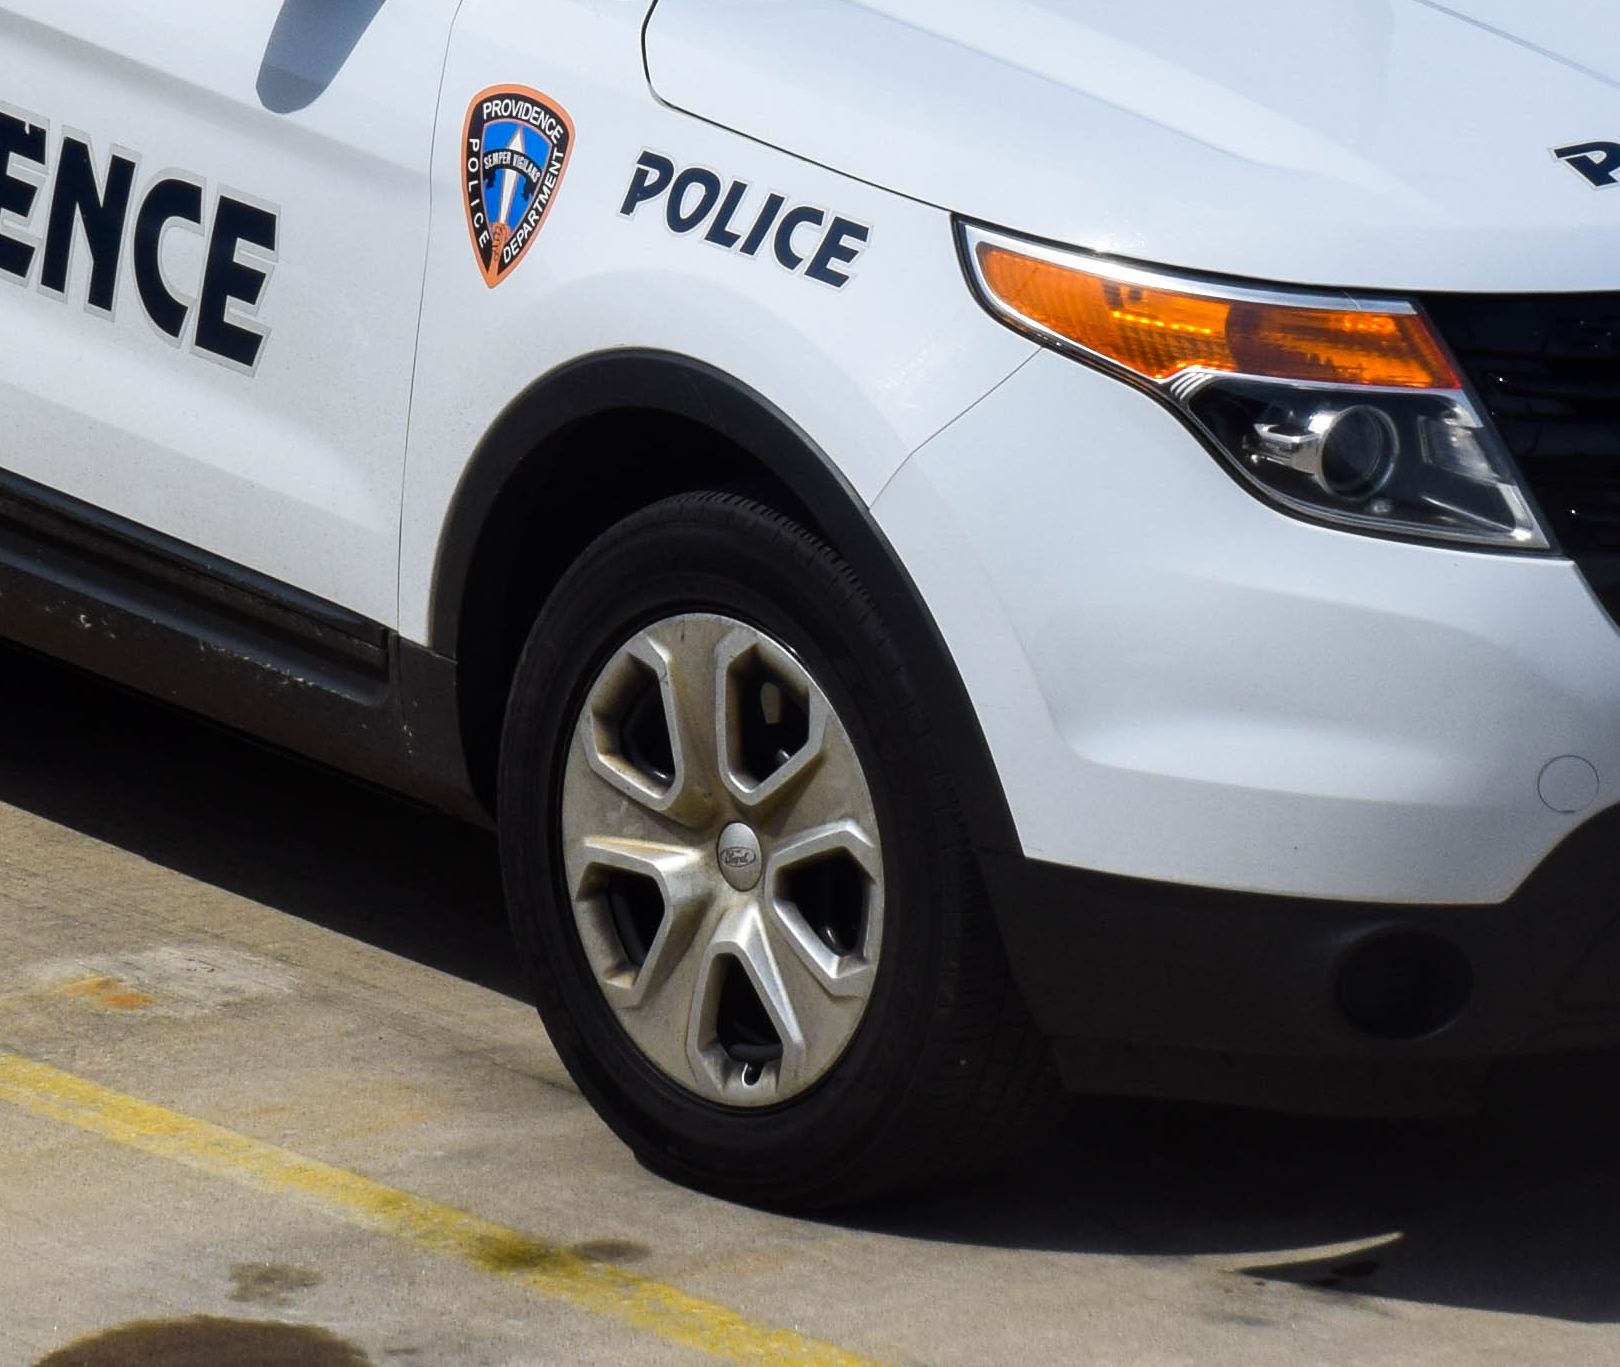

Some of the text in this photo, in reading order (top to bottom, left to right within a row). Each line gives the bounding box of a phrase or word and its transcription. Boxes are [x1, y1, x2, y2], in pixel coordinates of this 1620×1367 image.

[482, 99, 564, 144] PROVIDENCE
[483, 151, 512, 169] SEMPER
[467, 138, 490, 248] POLICE
[503, 147, 564, 263] DEPARTMENT
[619, 149, 871, 289] POLICE
